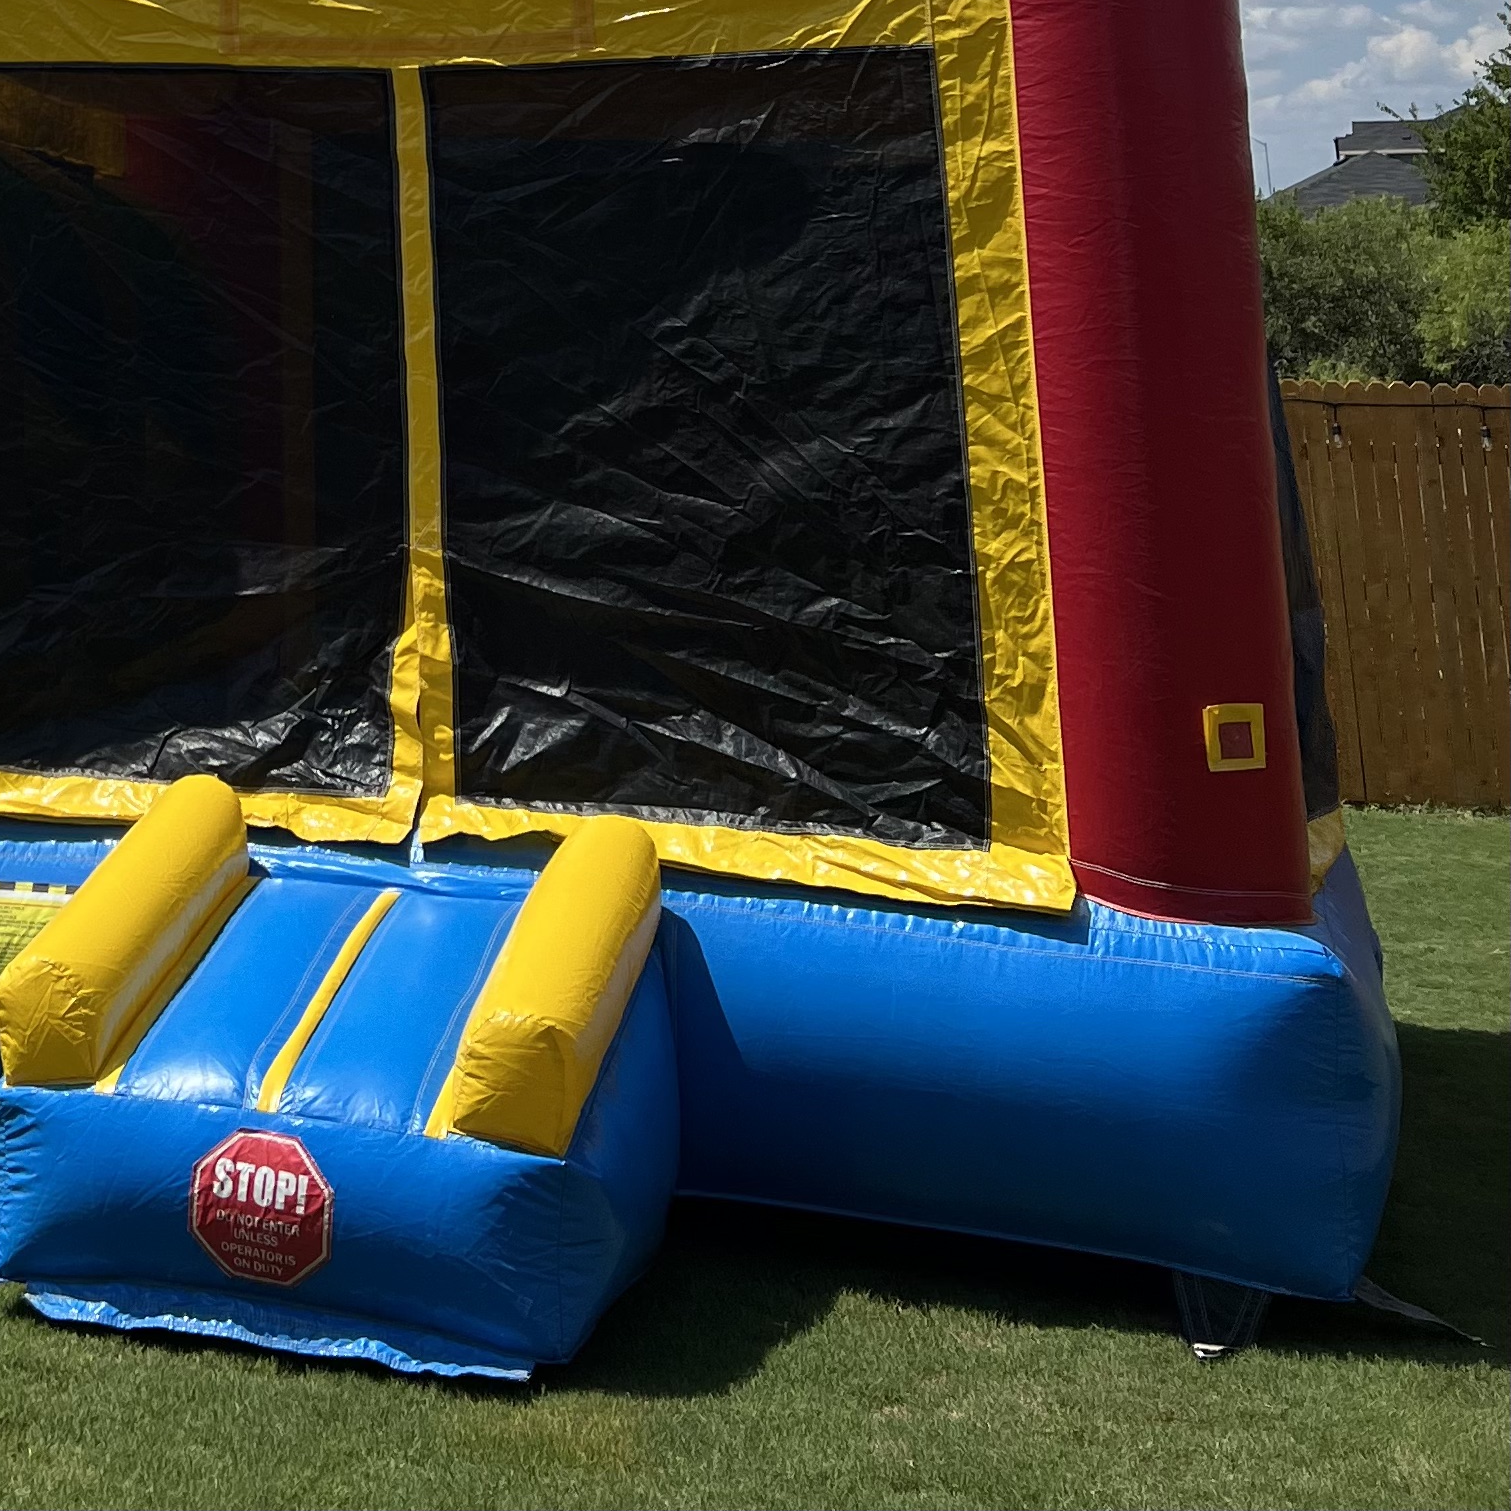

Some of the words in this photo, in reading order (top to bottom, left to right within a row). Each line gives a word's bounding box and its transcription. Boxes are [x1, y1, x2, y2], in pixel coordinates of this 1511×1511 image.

[212, 1157, 309, 1215] STOP!
[216, 1209, 234, 1223] DO
[237, 1213, 259, 1228] NOT
[262, 1218, 300, 1237] ENTER
[233, 1226, 279, 1247] UNLESS
[220, 1241, 284, 1263] OPERATOR
[284, 1253, 297, 1266] IS
[233, 1256, 251, 1269] ON
[253, 1260, 284, 1276] DUTY
